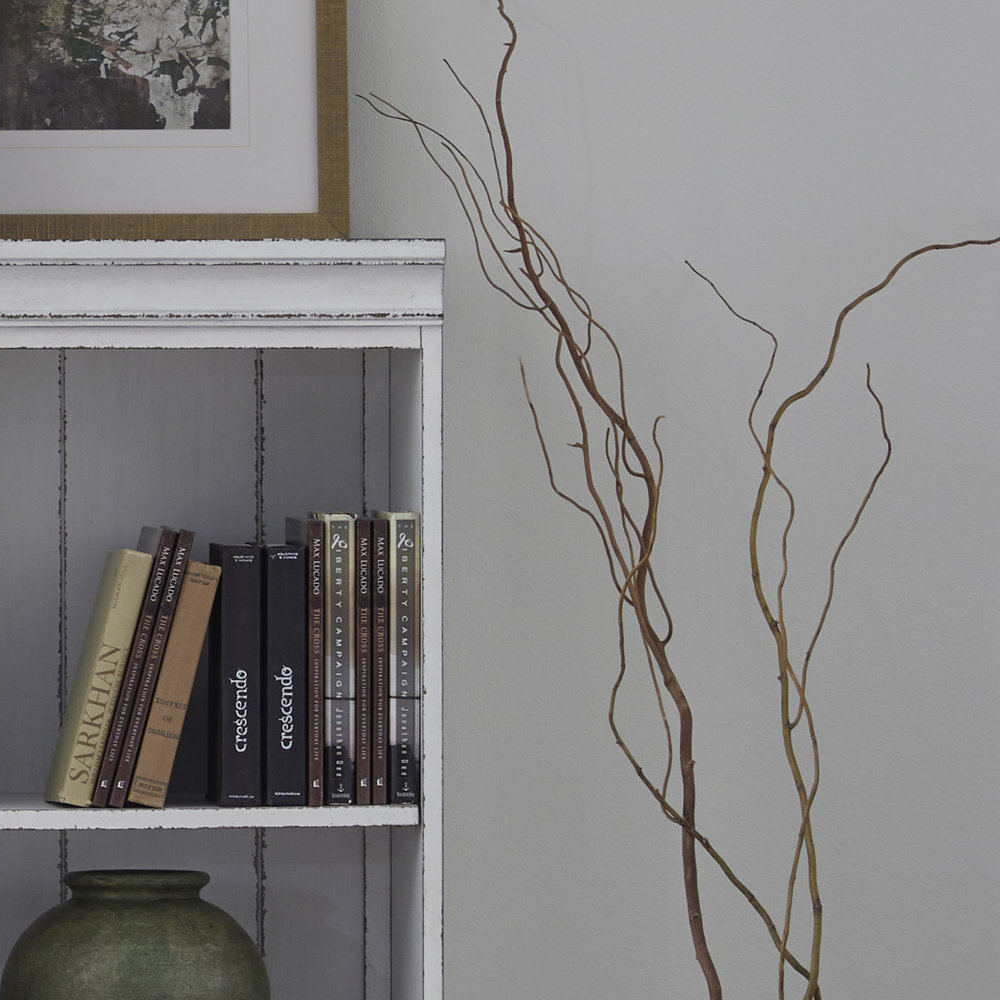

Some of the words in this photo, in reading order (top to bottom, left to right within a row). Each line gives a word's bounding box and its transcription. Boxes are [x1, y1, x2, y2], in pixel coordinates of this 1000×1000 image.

[159, 546, 171, 566] MAX
[174, 546, 186, 567] MAX
[331, 534, 348, 607] LIBERTY
[397, 533, 414, 607] LIBERTY
[149, 567, 166, 602] LUCADO
[164, 568, 181, 603] LUCADO
[360, 560, 368, 594] LUCADO
[142, 614, 152, 631] THE
[158, 615, 169, 632] THE
[134, 632, 148, 660] CROSS
[150, 633, 164, 660] CROSS
[69, 643, 120, 784] SARKHAN
[155, 696, 188, 711] STRANGE
[162, 715, 173, 723] SO
[229, 668, 248, 753] crescendo
[274, 666, 293, 750] crescendo
[147, 727, 180, 741] NOTHING
[400, 707, 409, 755] Jonathan
